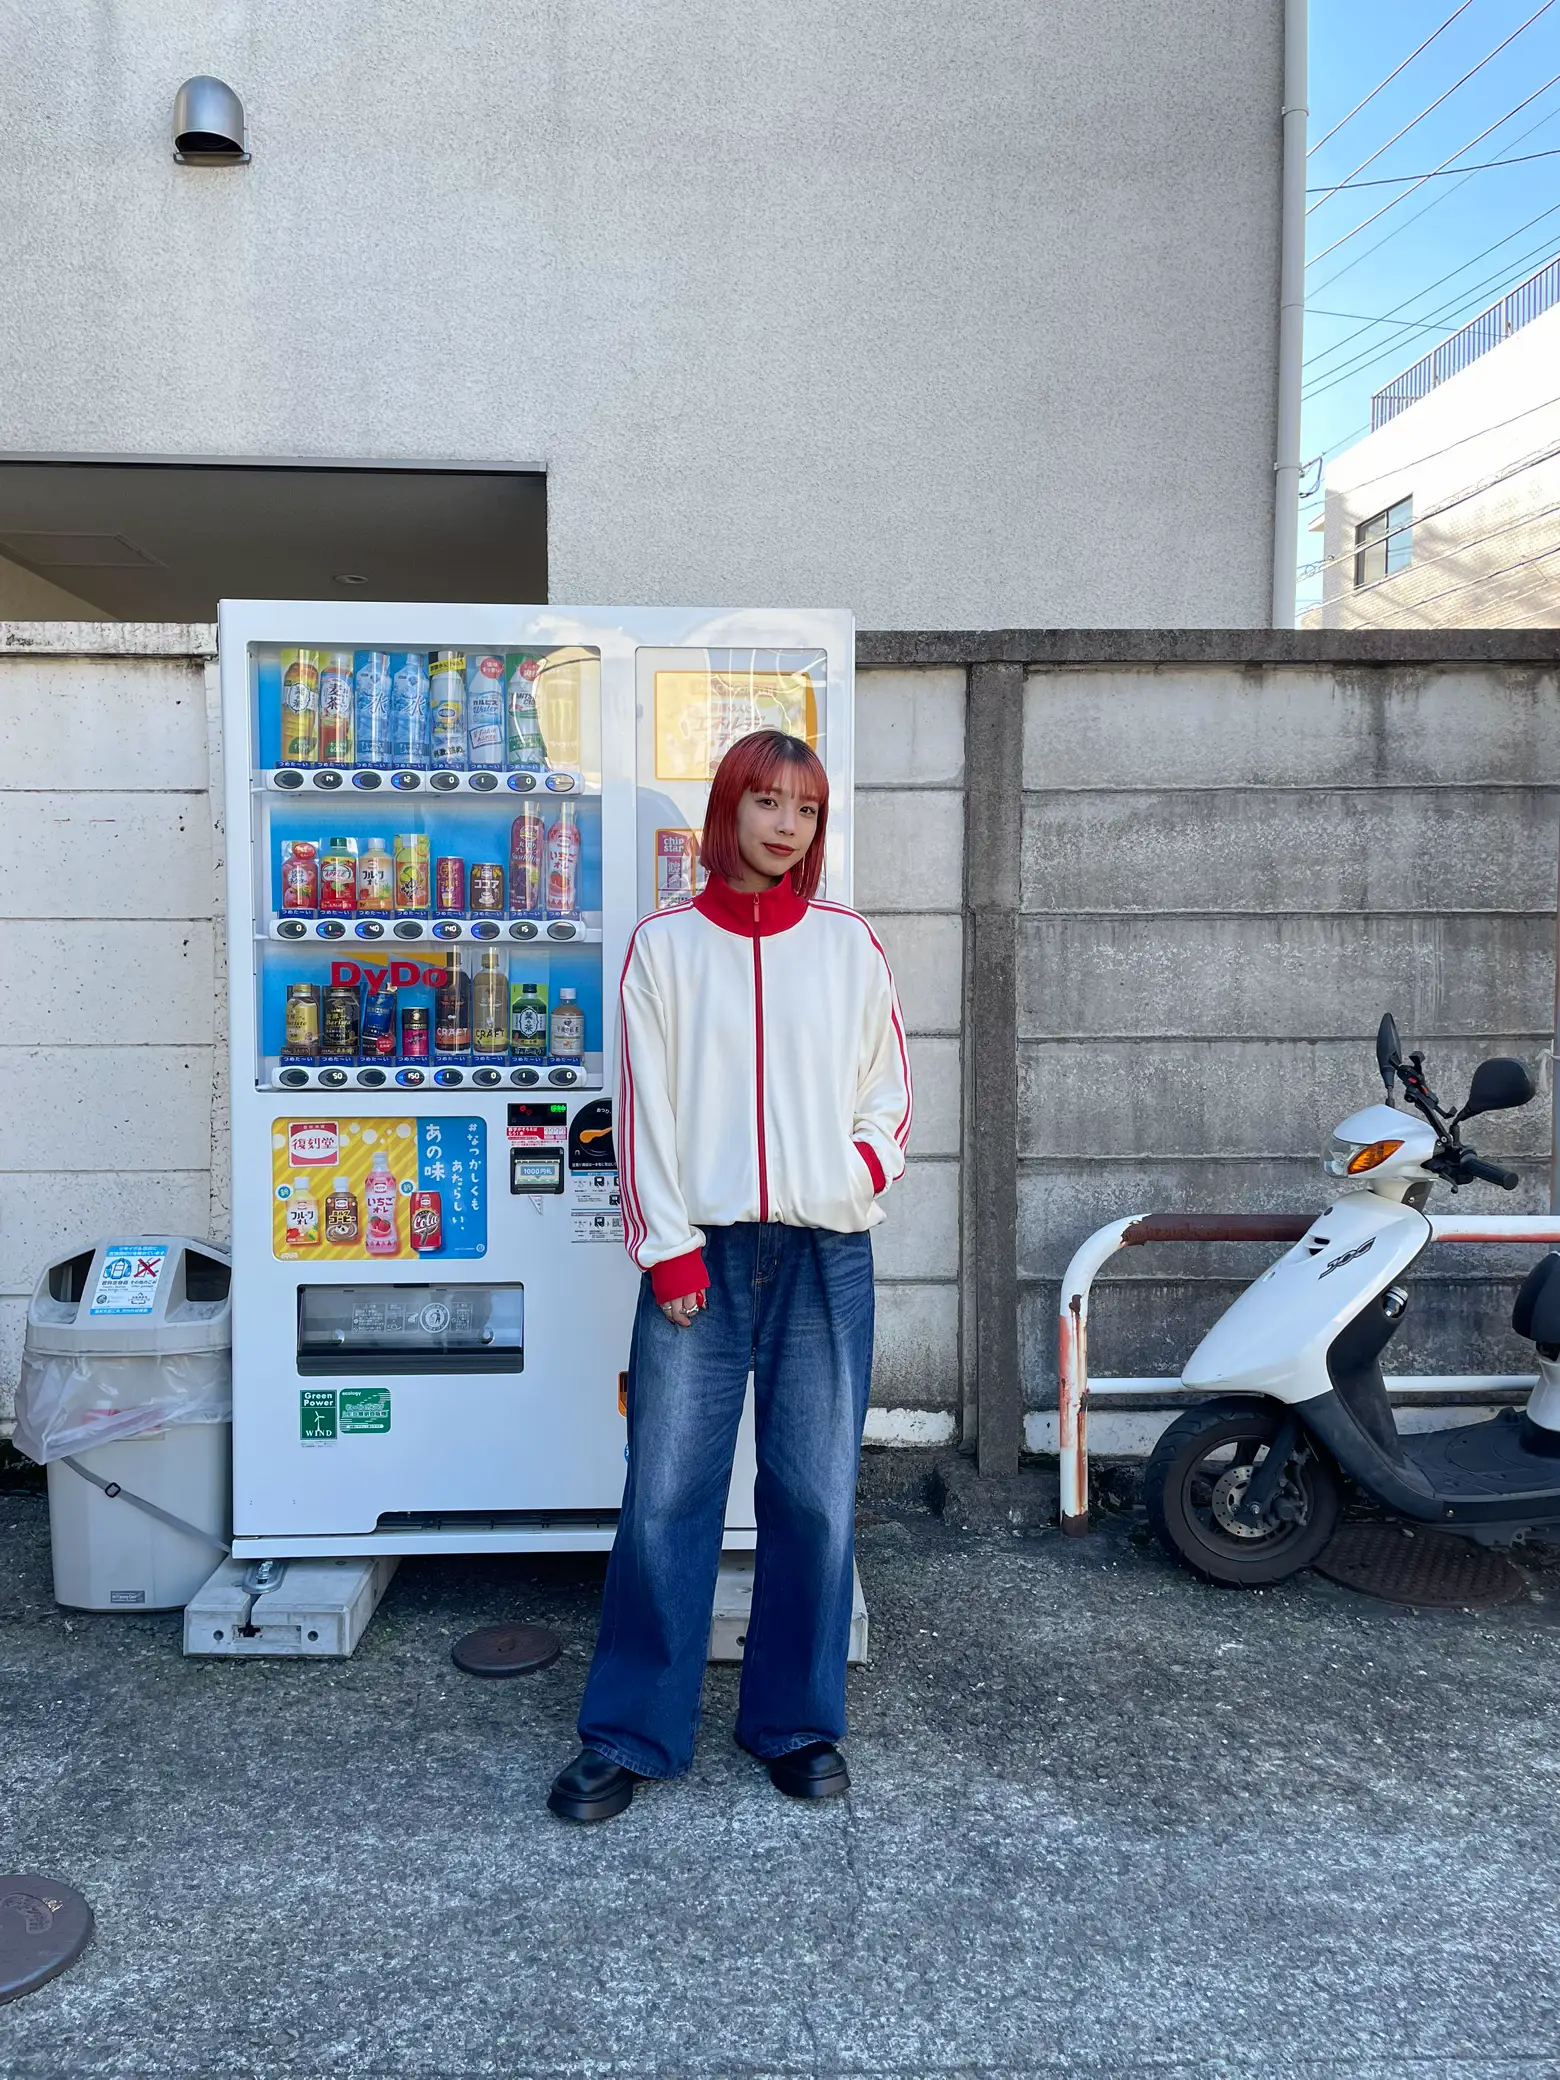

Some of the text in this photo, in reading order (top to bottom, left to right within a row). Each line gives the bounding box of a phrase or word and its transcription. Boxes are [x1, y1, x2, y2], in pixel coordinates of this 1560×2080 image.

[361, 691, 389, 714] 水
[399, 693, 426, 717] 水
[473, 705, 499, 713] Water
[663, 836, 684, 845] chip
[549, 850, 577, 863] いちご
[474, 879, 500, 889] ココア
[331, 961, 448, 995] DyDo
[436, 1027, 468, 1036] CRAFT
[475, 1029, 505, 1038] CRAFT
[292, 1137, 335, 1150] 復刻堂
[424, 1123, 446, 1182] あの味
[367, 1196, 395, 1207] いちご
[290, 1211, 314, 1220] フルーツ
[329, 1216, 356, 1224] コーヒー
[414, 1212, 439, 1229] Cola
[1317, 1236, 1377, 1281] JOG
[304, 1392, 333, 1400] Green
[303, 1399, 334, 1407] Power
[305, 1429, 333, 1437] WIND
